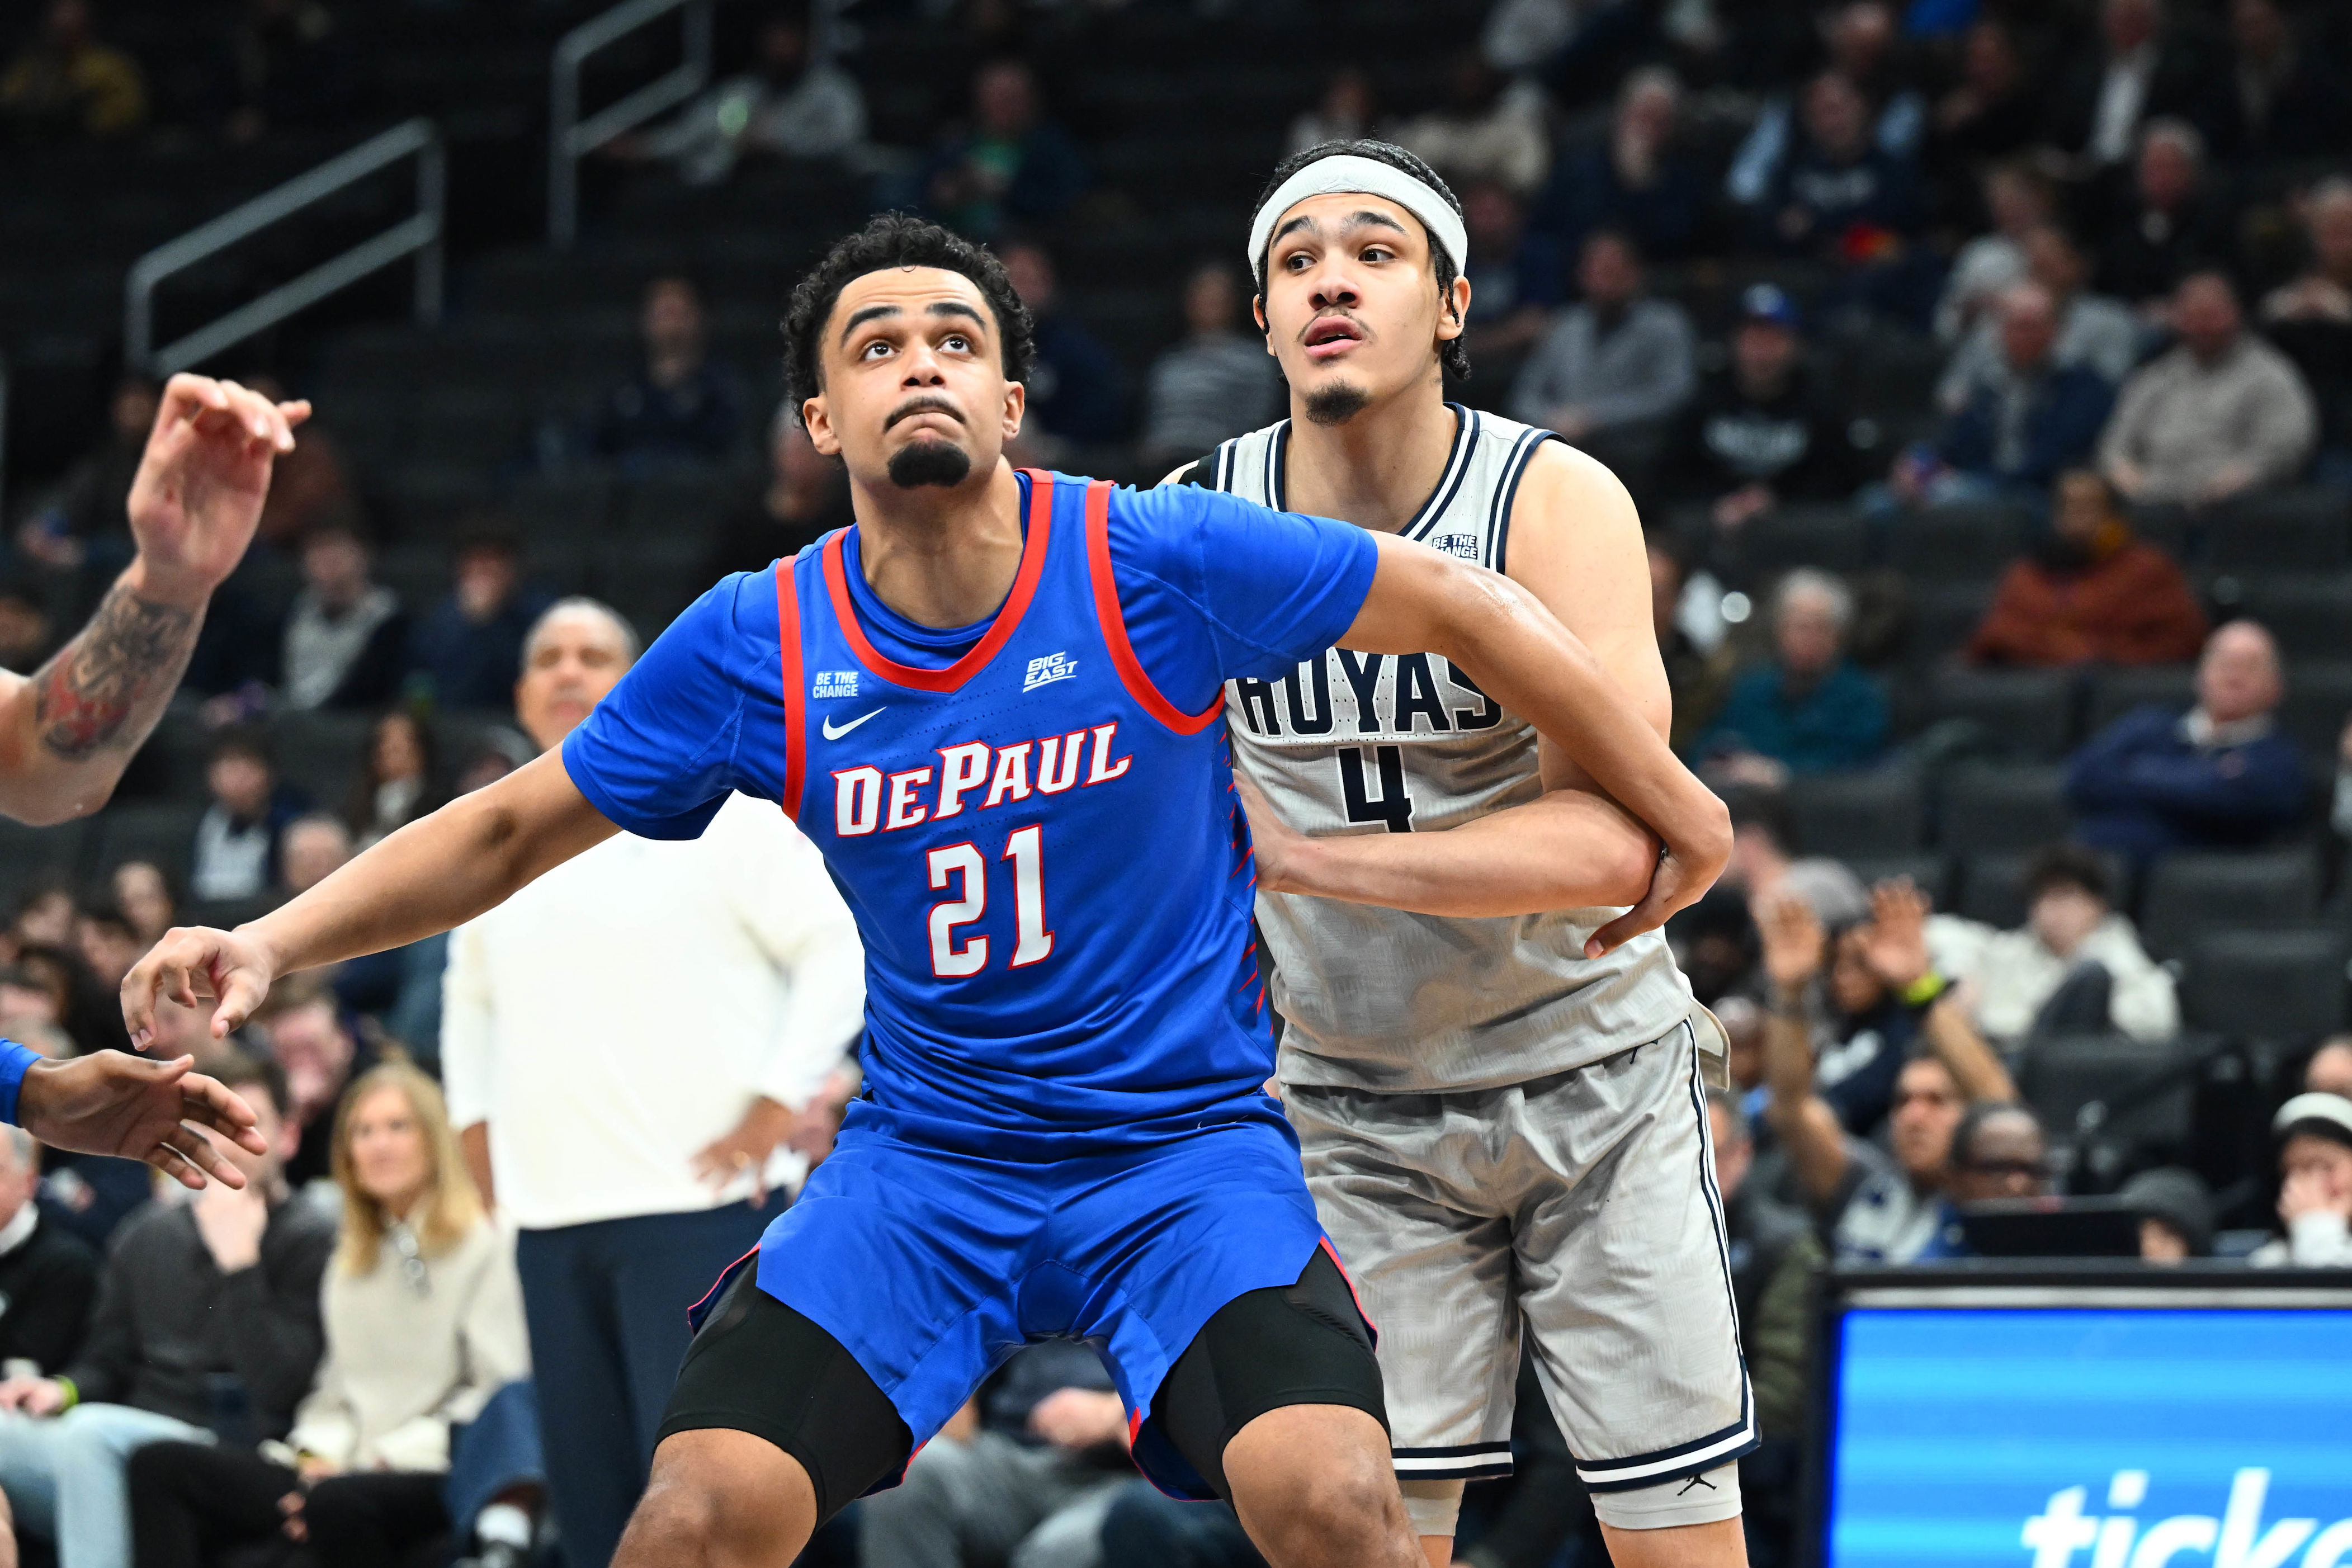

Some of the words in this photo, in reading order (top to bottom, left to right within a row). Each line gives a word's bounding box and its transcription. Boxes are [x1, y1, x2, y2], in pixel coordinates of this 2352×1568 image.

[1432, 536, 1449, 549] BE
[1452, 535, 1476, 547] THE
[1440, 546, 1477, 559] ANGE
[1024, 660, 1078, 686] EAST
[1027, 651, 1065, 673] BIG
[816, 673, 832, 685] BE
[834, 672, 858, 684] THE
[813, 684, 859, 698] CHANGE
[830, 721, 1133, 838] DEPAUL
[1334, 744, 1416, 833] 4
[925, 823, 1055, 978] 21
